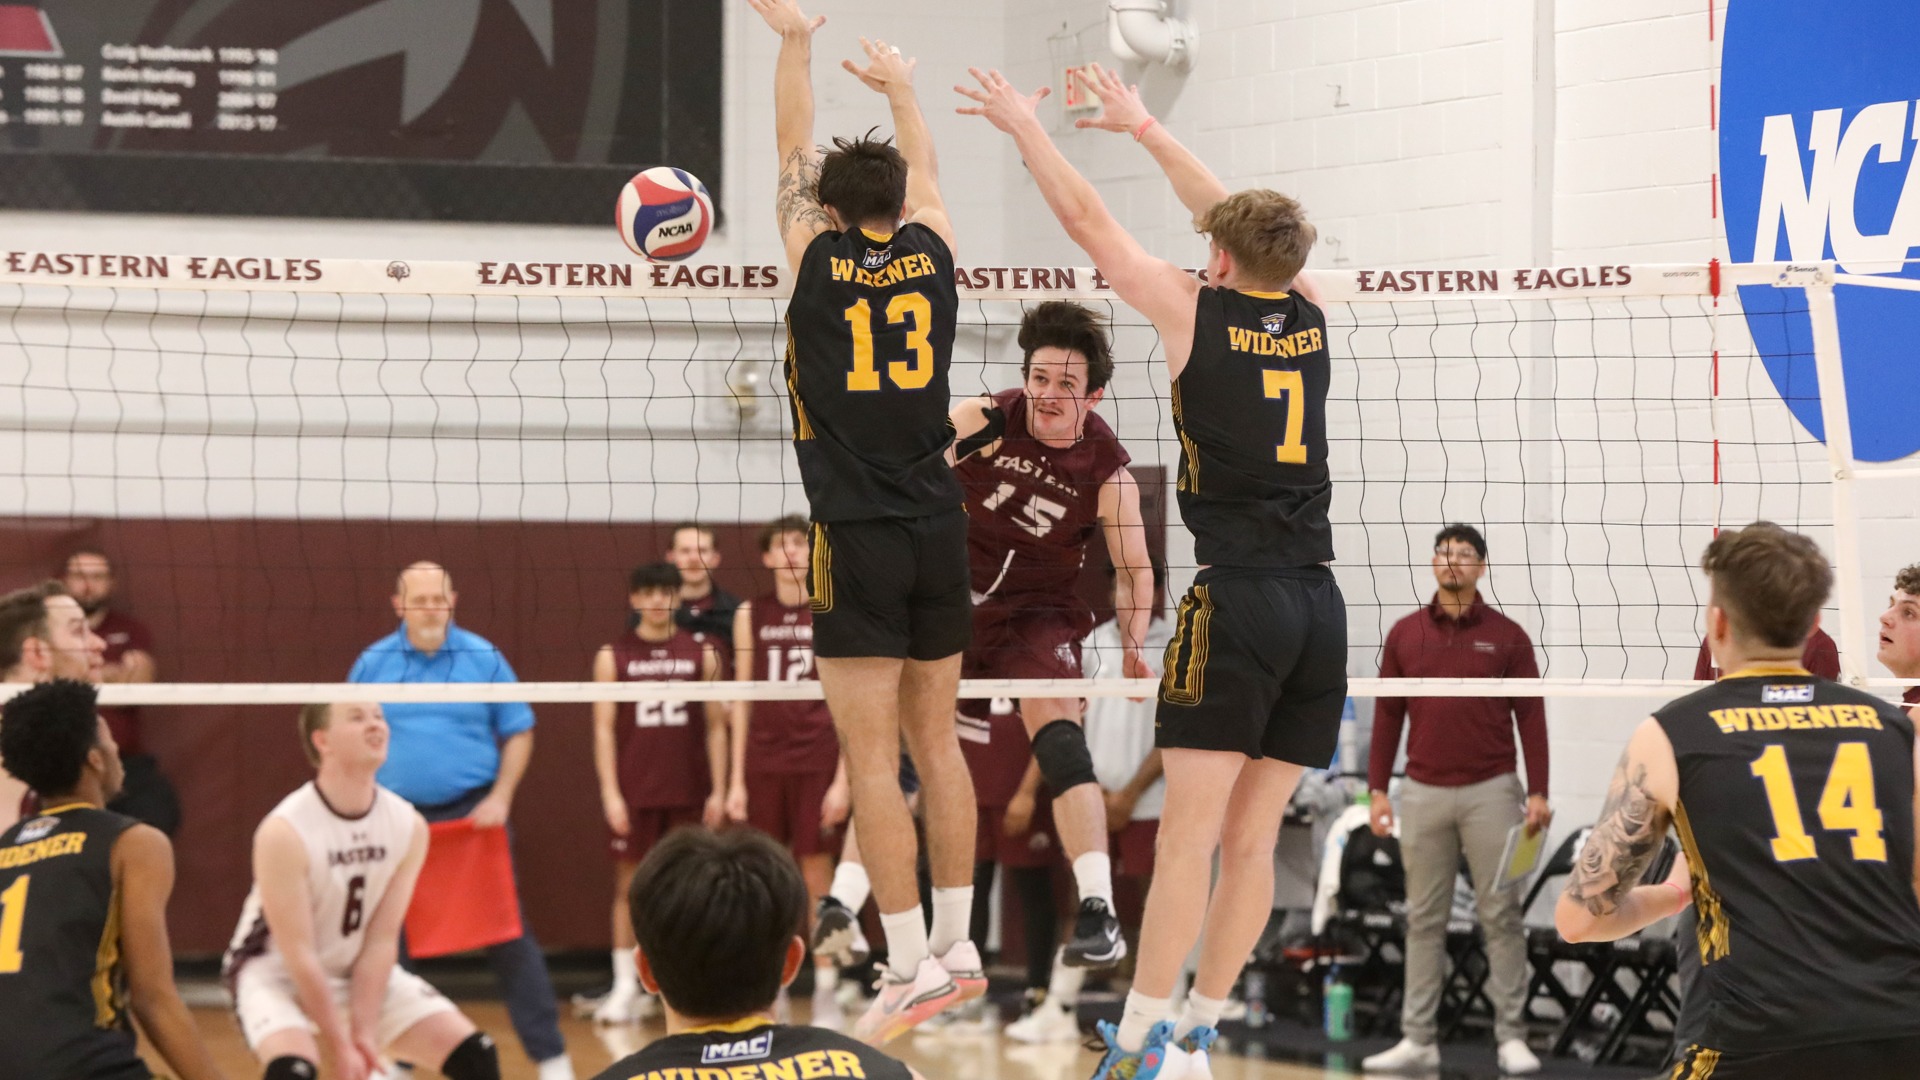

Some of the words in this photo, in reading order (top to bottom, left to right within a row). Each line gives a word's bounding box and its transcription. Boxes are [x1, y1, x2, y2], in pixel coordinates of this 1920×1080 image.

[658, 223, 693, 238] NCAA
[6, 252, 169, 279] EASTERN
[188, 257, 323, 281] EAGLES
[478, 262, 632, 288] EASTERN
[649, 264, 779, 289] EAGLES
[955, 267, 1076, 290] ASTERN
[1357, 270, 1498, 293] EASTERN
[1514, 265, 1632, 289] EAGLES
[844, 291, 934, 391] 13
[1262, 369, 1307, 464] 7
[982, 482, 1067, 538] 15
[1709, 704, 1884, 734] WIDENER
[1749, 742, 1888, 863] 14
[341, 876, 366, 938] 6
[707, 1036, 768, 1058] MAC
